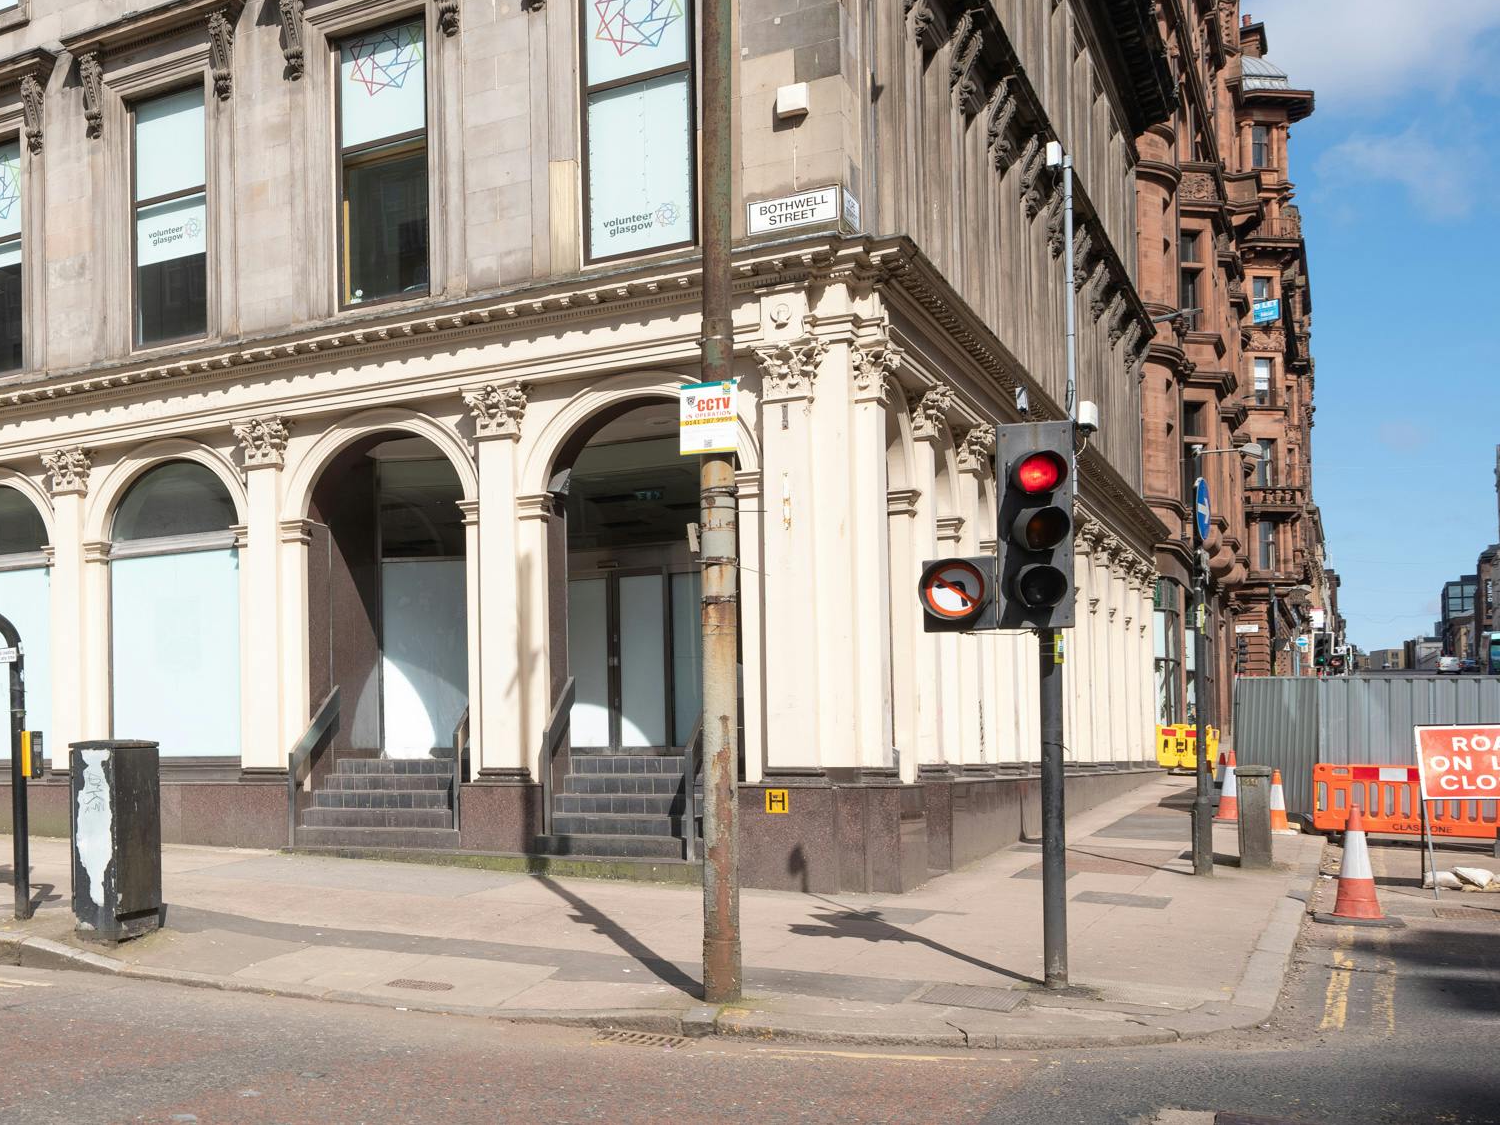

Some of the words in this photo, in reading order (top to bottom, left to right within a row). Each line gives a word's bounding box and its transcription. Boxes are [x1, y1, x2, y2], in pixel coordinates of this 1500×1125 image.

[759, 194, 828, 216] BOTHWELL
[603, 212, 653, 228] volunteer
[768, 207, 817, 225] STREET
[148, 225, 183, 239] volunteer
[609, 221, 653, 238] glasgow
[152, 233, 184, 247] glasgow
[697, 396, 731, 412] CCTV
[695, 410, 732, 418] OPERATION
[716, 415, 733, 423] 9999
[1430, 755, 1473, 772] ON
[1440, 774, 1500, 790] CLO
[1392, 823, 1426, 832] CLAS
[1430, 825, 1453, 834] ONE
